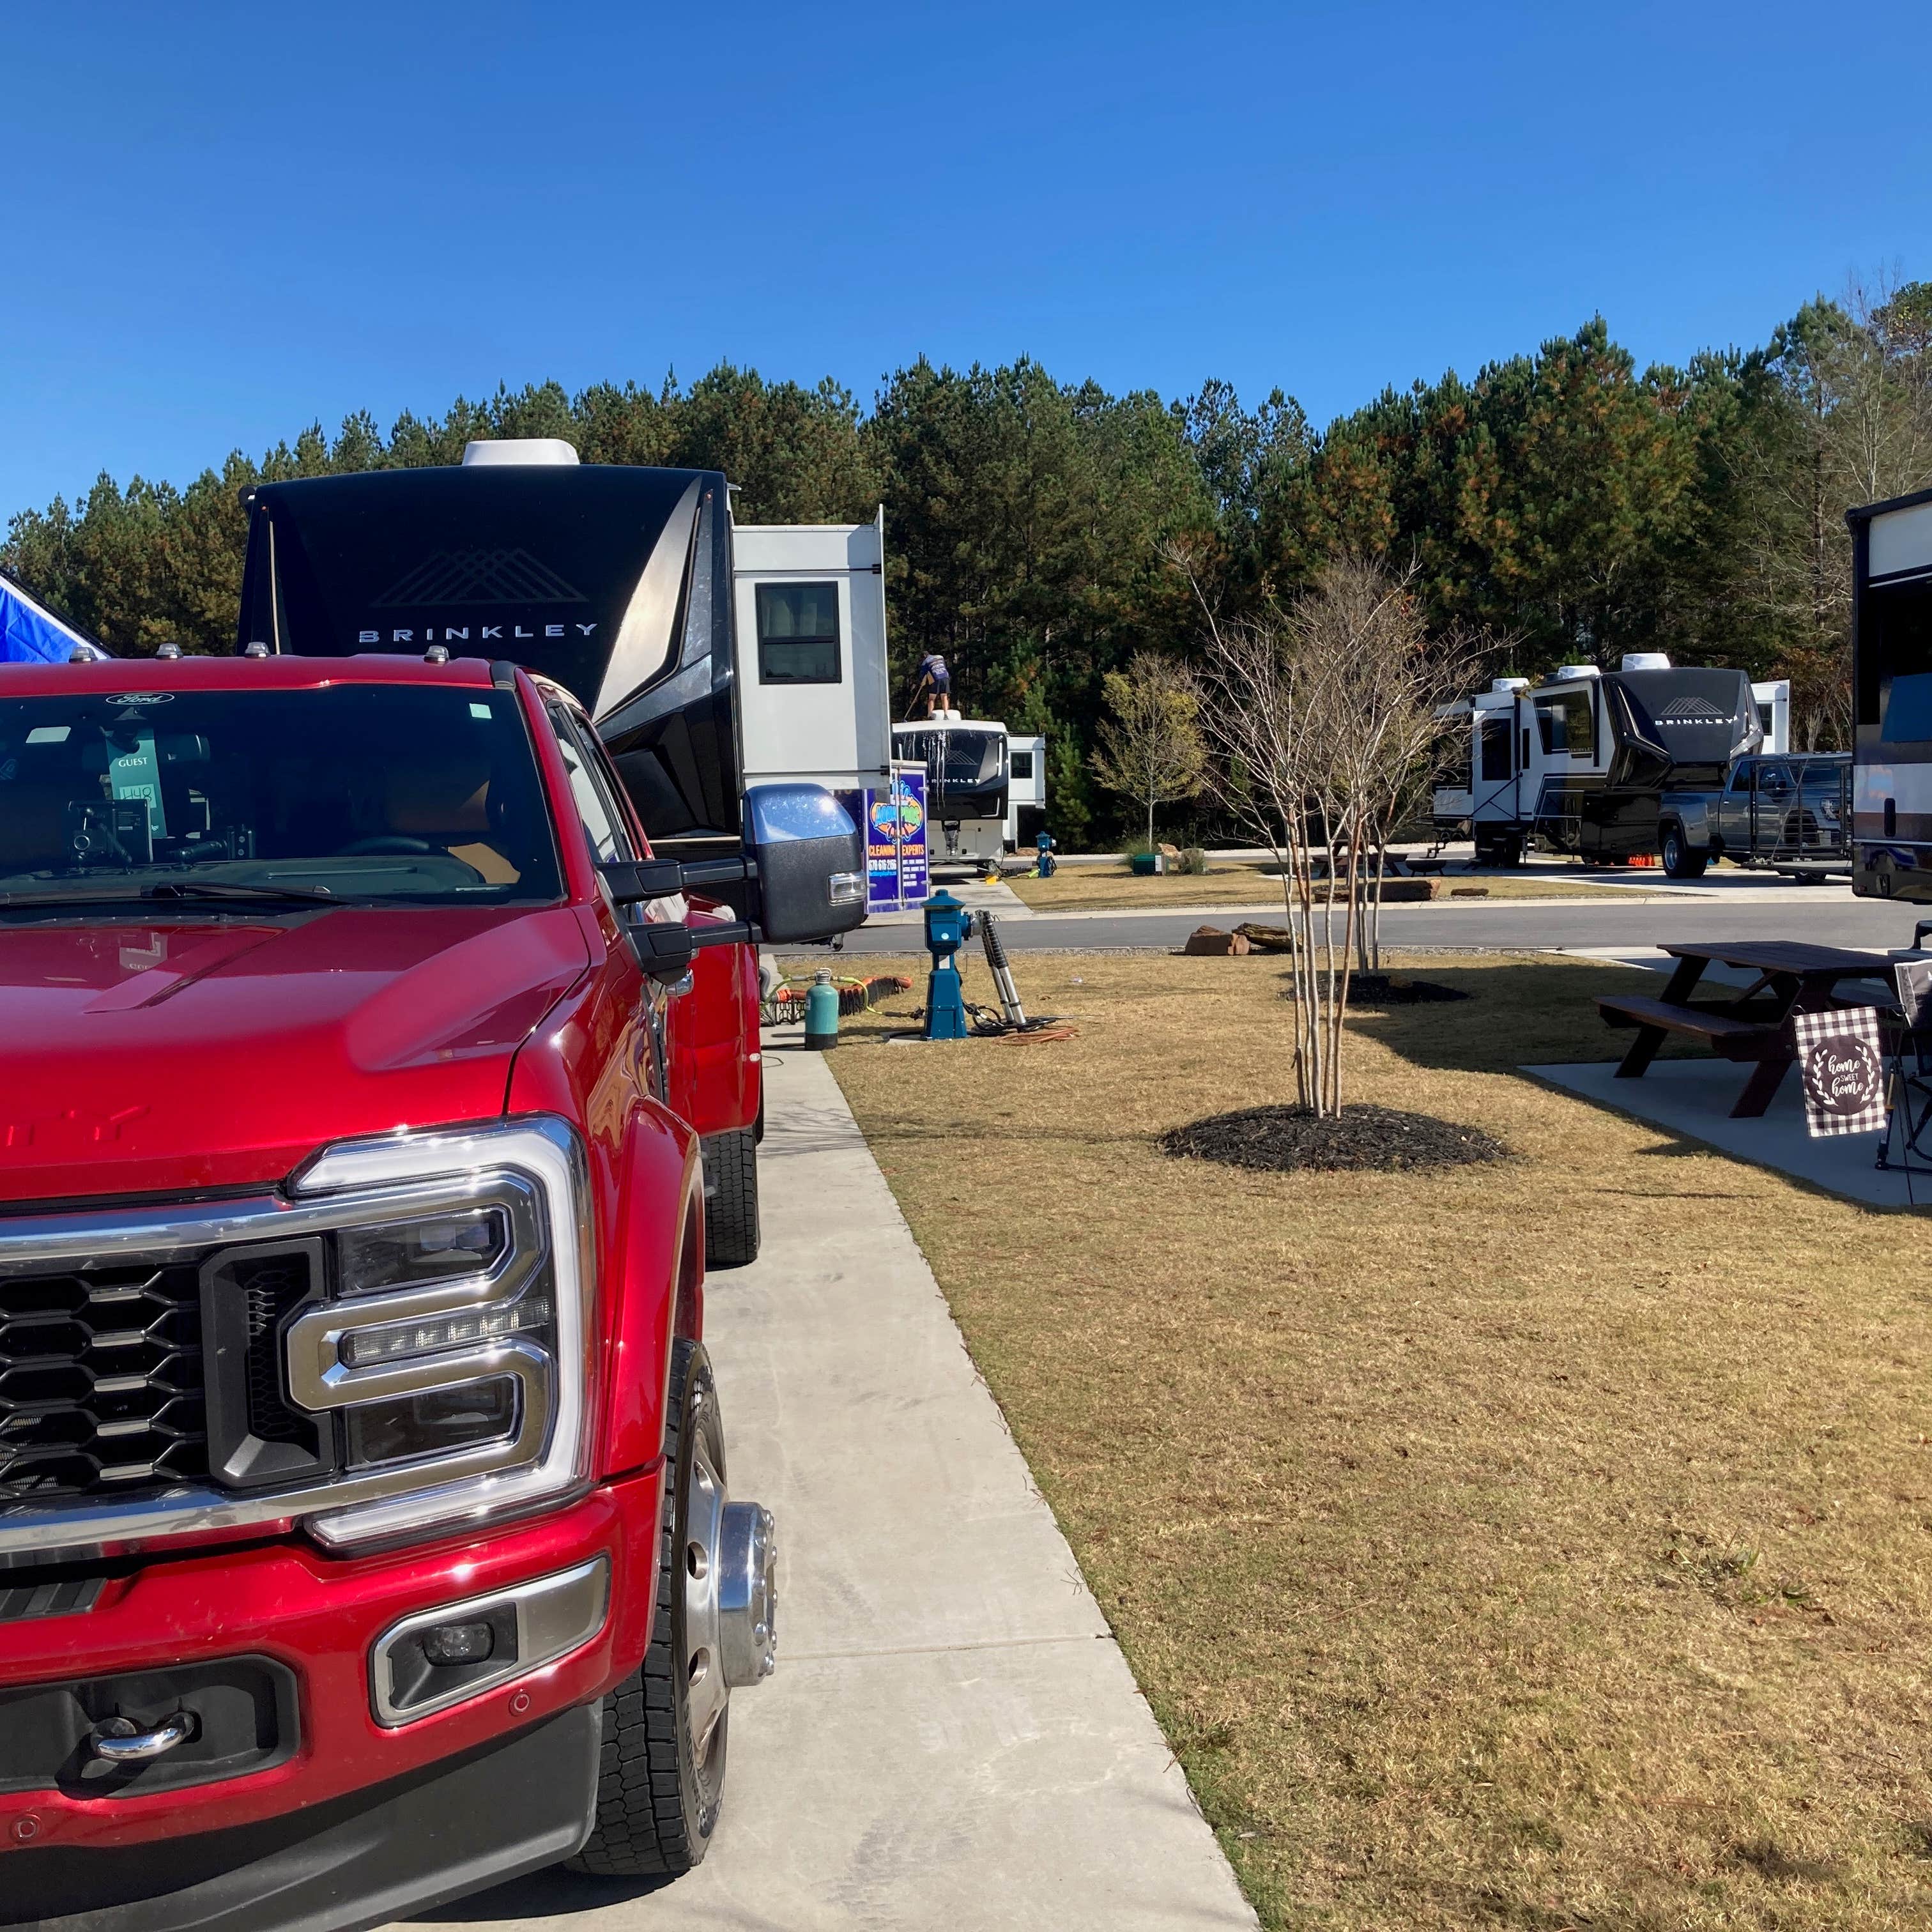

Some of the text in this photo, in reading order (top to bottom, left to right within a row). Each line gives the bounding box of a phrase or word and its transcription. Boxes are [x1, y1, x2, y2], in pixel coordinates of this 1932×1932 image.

[359, 623, 598, 643] BRINKLEY
[118, 756, 148, 767] GUEST
[868, 844, 924, 856] CLEANING EXPERTS
[1828, 1054, 1861, 1075] home
[1840, 1073, 1859, 1082] SWEET
[1831, 1077, 1864, 1097] home
